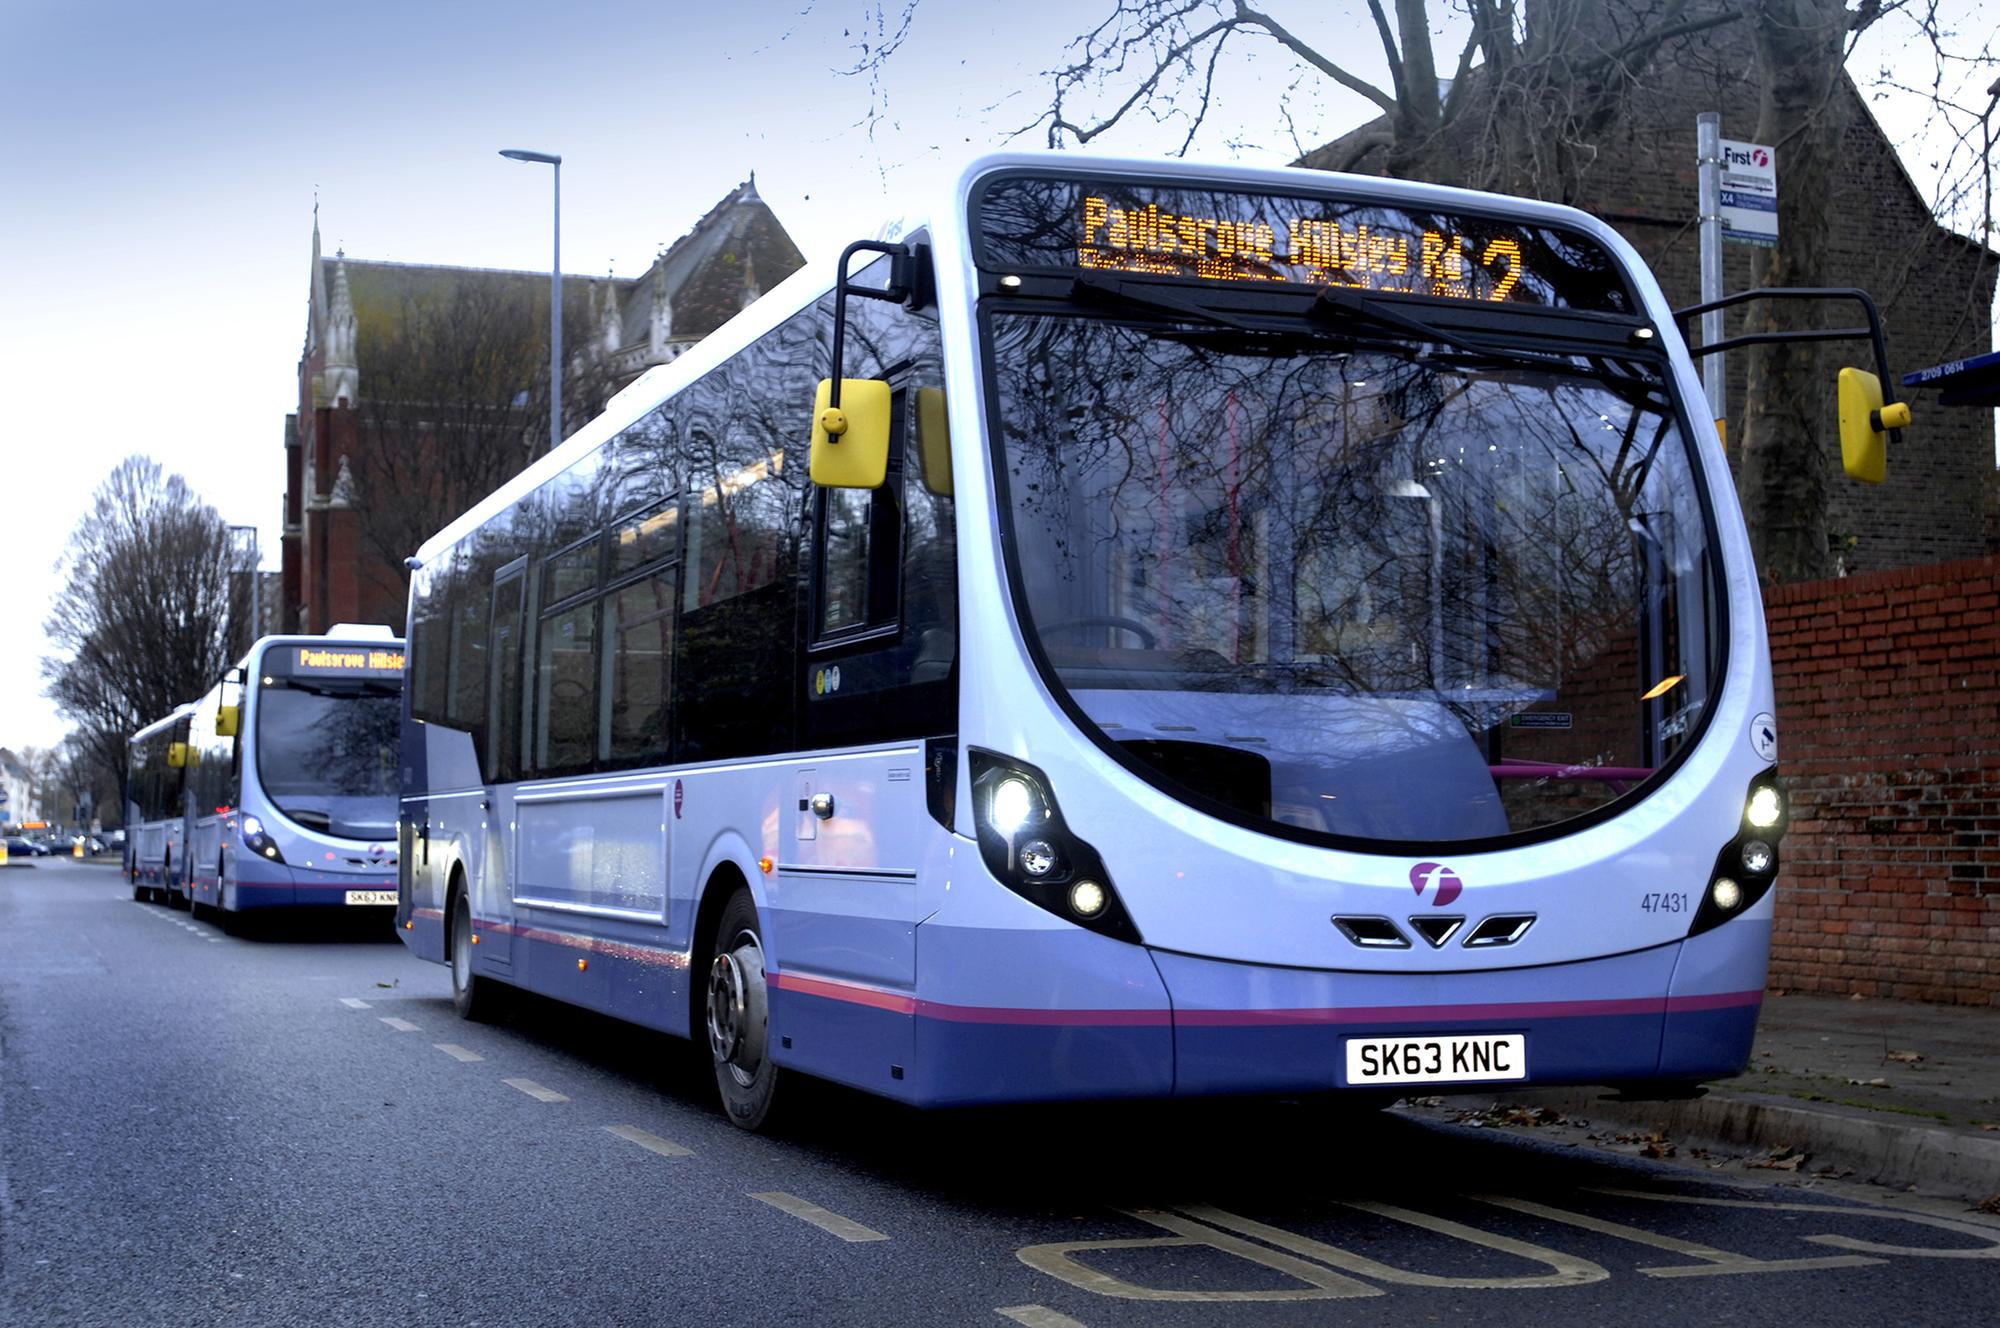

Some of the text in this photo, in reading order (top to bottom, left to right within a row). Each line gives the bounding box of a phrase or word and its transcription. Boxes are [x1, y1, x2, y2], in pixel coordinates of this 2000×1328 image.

[1724, 147, 1751, 165] First
[1721, 192, 1734, 203] X4
[1083, 197, 1521, 300] Paulsgrove Hillsley Rd 2
[1921, 367, 1942, 381] 2709
[300, 649, 406, 669] Paulsgrove Hillsle
[1641, 893, 1688, 913] 47431
[1361, 1040, 1510, 1076] SK63 KNC
